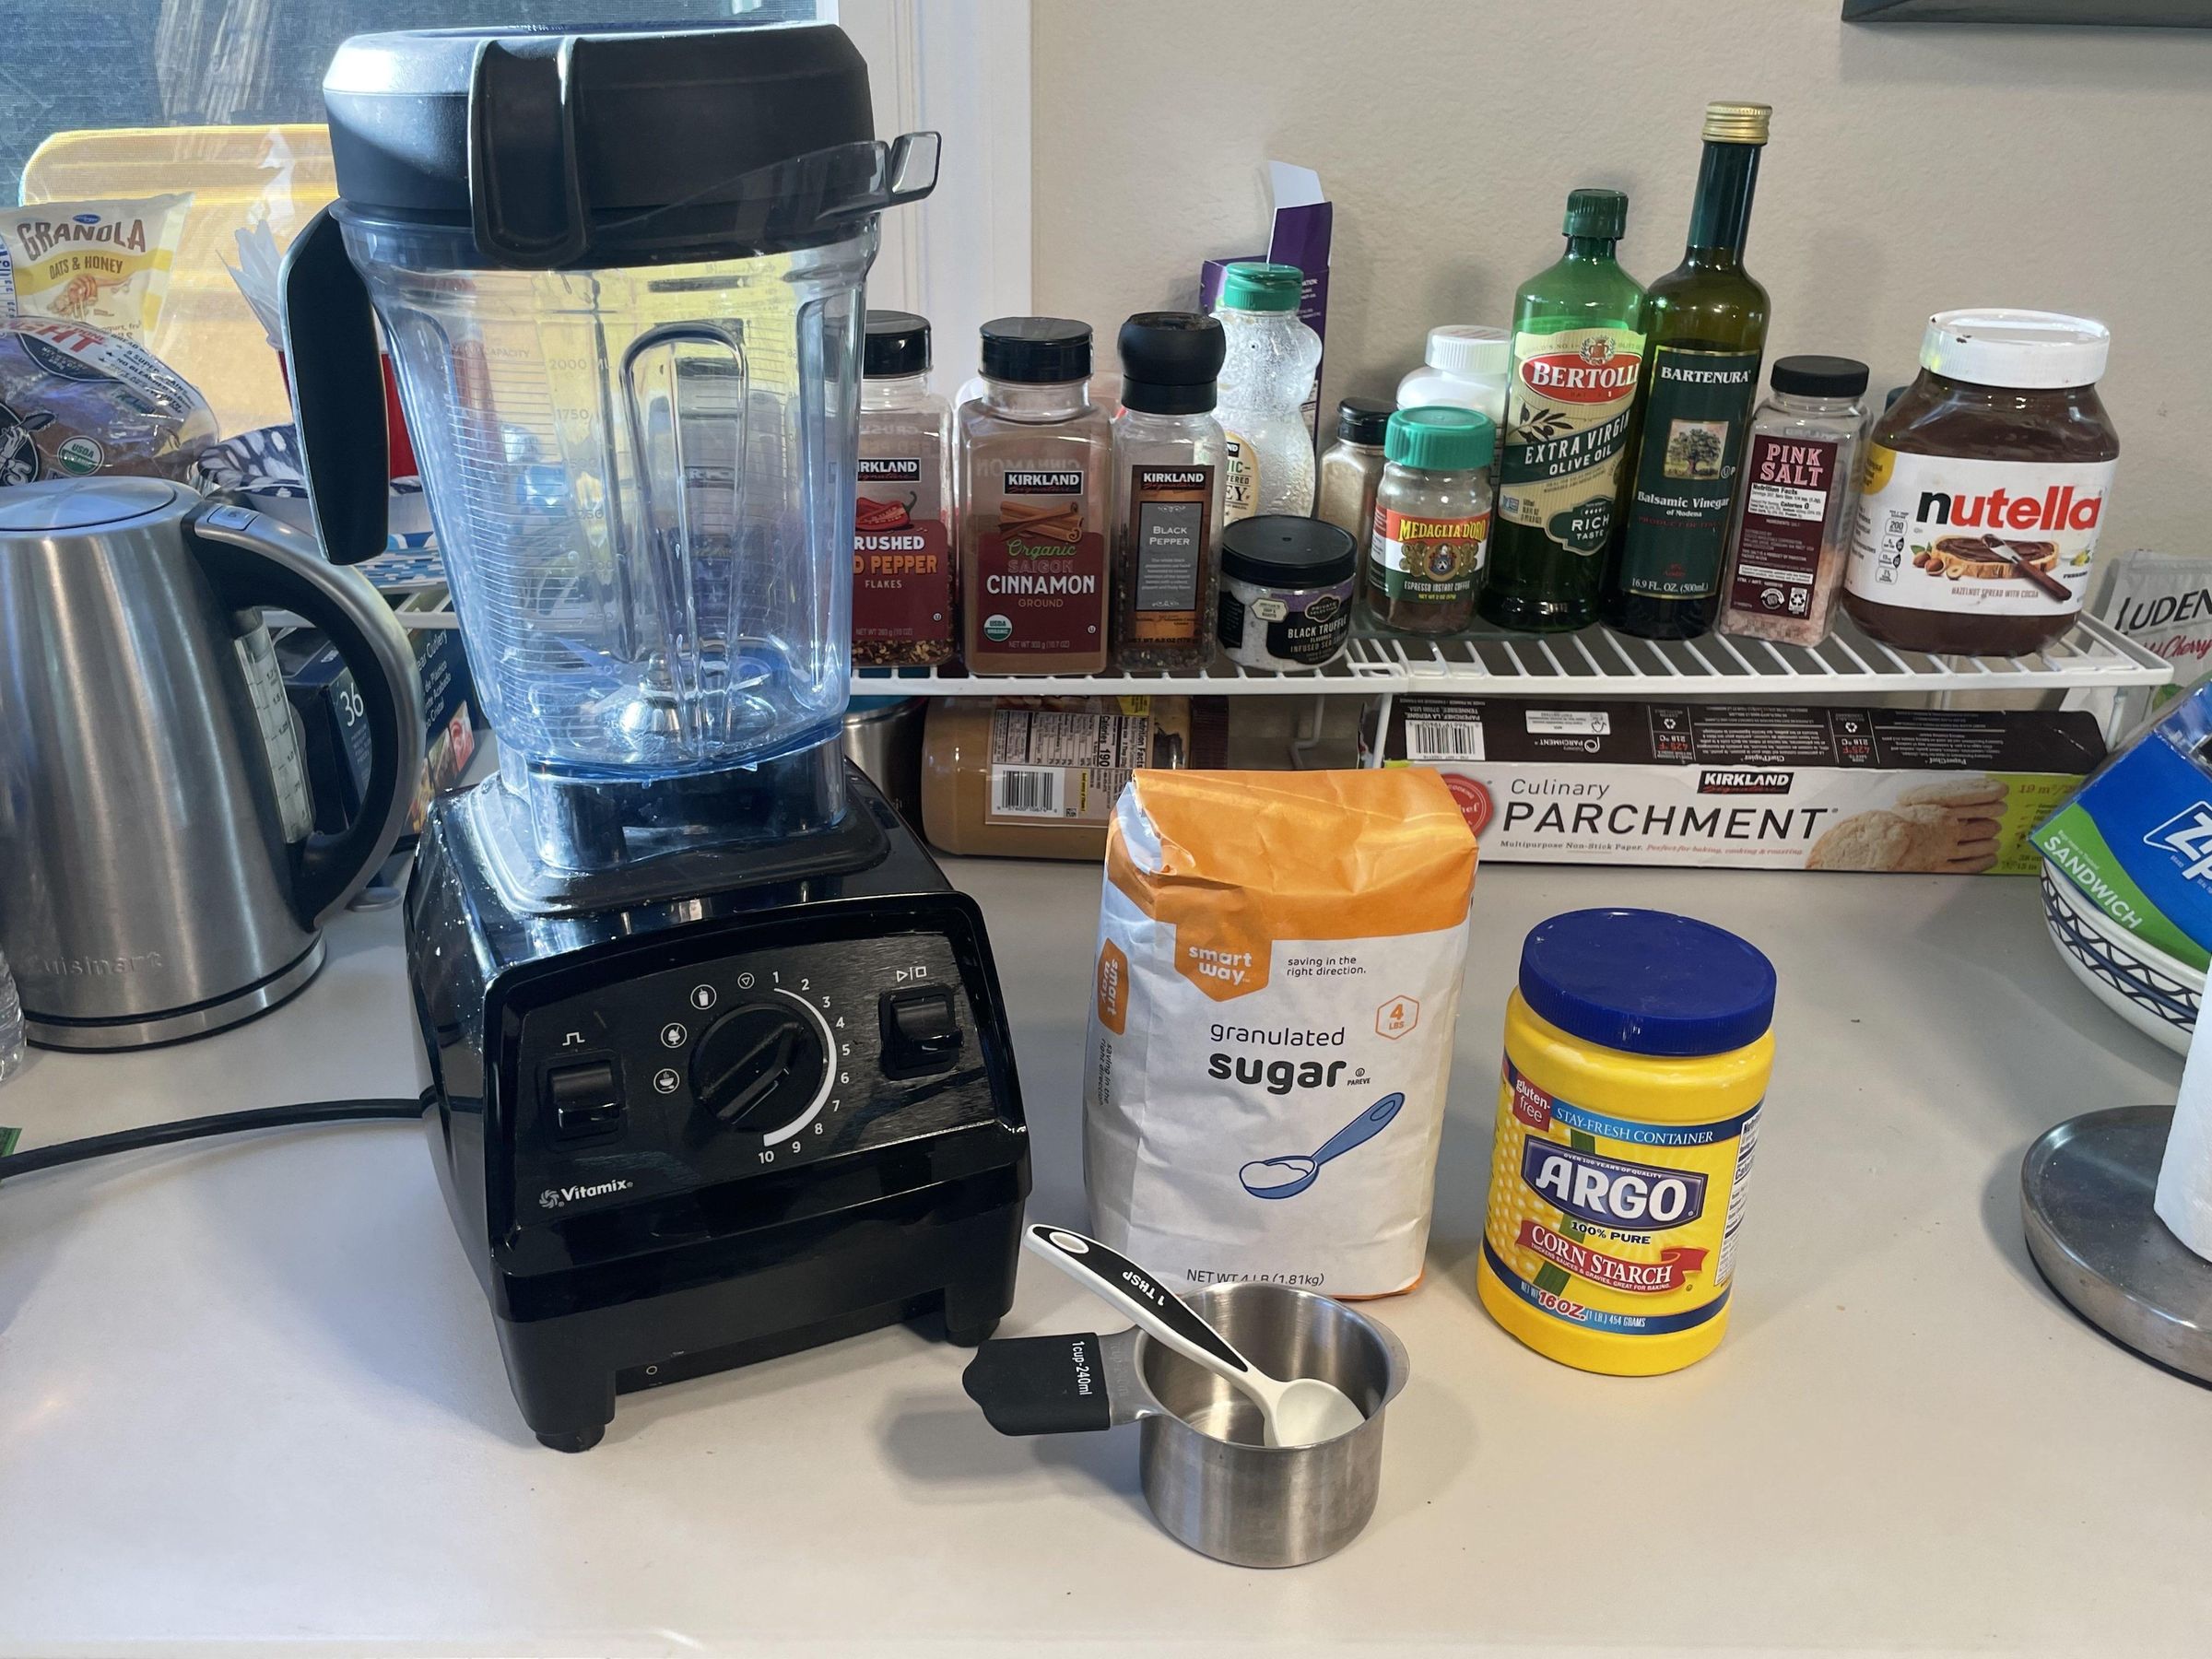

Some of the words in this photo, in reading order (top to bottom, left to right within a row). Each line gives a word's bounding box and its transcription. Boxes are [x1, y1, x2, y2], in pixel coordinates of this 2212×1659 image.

[18, 219, 146, 261] GRANOLA
[50, 257, 70, 279] OATS
[72, 257, 80, 270] &
[85, 256, 123, 274] HONEY
[548, 359, 587, 370] 2000
[1661, 366, 1748, 384] BARTENURA
[557, 409, 589, 420] 1750
[1524, 436, 1581, 465] EXTRA
[1588, 409, 1630, 451] VIRGIN
[71, 443, 95, 459] USDA
[1549, 452, 1591, 476] OLIVE
[1594, 443, 1613, 463] OIL
[1766, 442, 1823, 466] PINK
[1008, 474, 1080, 486] KIRKLAND
[1143, 472, 1205, 483] KIRKLAND
[1759, 462, 1824, 488] SALT
[1753, 483, 1780, 493] Nutrition
[1781, 487, 1798, 495] Facts
[1637, 491, 1688, 508] Balsamic
[1693, 496, 1730, 511] Vinegar
[1781, 500, 1803, 509] Calories
[1916, 486, 2102, 531] nutella
[1571, 513, 1610, 532] RICH
[1676, 510, 1702, 518] Modena
[1398, 519, 1461, 542] MEDAGLIA
[1889, 521, 1904, 531] 200
[853, 535, 925, 550] RUSHED
[1577, 530, 1605, 541] TASTE
[1006, 539, 1077, 560] Organic
[870, 555, 938, 575] PEPPER
[1008, 559, 1074, 574] SAIGON
[865, 580, 902, 589] FLAKES
[986, 575, 1095, 594] CINNAMON
[1404, 581, 1431, 593] ESPRESSO
[1631, 578, 1648, 589] 16.9
[1648, 581, 1662, 591] FL.
[1664, 582, 1678, 593] OZ.
[1951, 586, 1981, 597] HAZELNUT
[1981, 587, 2005, 598] SPREAD
[2005, 588, 2019, 598] WITH
[2020, 590, 2039, 598] COCOA
[1018, 598, 1064, 608] GROUND
[1288, 628, 1316, 639] BLACK
[426, 629, 449, 660] Cutlery
[339, 682, 364, 727] 36
[1099, 715, 1111, 745] Calories
[1540, 738, 1583, 747] PARCHMENT
[1099, 748, 1111, 767] 190
[1135, 748, 1147, 769] Facts
[1704, 772, 1790, 786] KIRKLAND
[1511, 778, 1610, 800] Culinary
[1502, 802, 1829, 841] PARCHMENT
[1500, 840, 1563, 850] Multipurpose
[1566, 841, 1612, 851] Non-Stick
[1616, 843, 1643, 852] Paper.
[2043, 836, 2143, 930] SANDWICH
[1188, 946, 1252, 968] smart
[1288, 957, 1322, 968] saving
[1325, 956, 1335, 966] in
[1339, 956, 1357, 965] the
[772, 971, 781, 983] 1
[1199, 962, 1246, 985] way
[1287, 966, 1312, 978] right
[1316, 965, 1367, 977] direction.
[800, 978, 810, 991] 2
[1100, 960, 1109, 1004] way
[1108, 959, 1119, 1016] smart
[822, 995, 830, 1009] 3
[1390, 1004, 1405, 1022] 4
[835, 1017, 845, 1030] 4
[1389, 1020, 1405, 1030] LBS
[1210, 1023, 1346, 1047] granulated
[841, 1044, 850, 1056] 5
[840, 1072, 850, 1085] 6
[1105, 1075, 1112, 1086] in
[1207, 1053, 1347, 1095] sugar
[1347, 1077, 1371, 1086] PAREVE
[1516, 1078, 1550, 1110] gluten-
[832, 1100, 841, 1112] 7
[1519, 1095, 1544, 1123] free
[814, 1122, 823, 1135] 8
[1556, 1108, 1630, 1139] STAY-FRESH
[1633, 1130, 1713, 1145] CONTAINER
[792, 1141, 801, 1153] 9
[758, 1150, 774, 1164] 10
[1563, 1153, 1582, 1163] OVER
[1596, 1161, 1619, 1172] YEARS
[1630, 1168, 1663, 1179] QUALITY
[561, 1179, 627, 1203] Vitamix
[1535, 1155, 1688, 1222] ARGO
[1571, 1221, 1606, 1240] 100%
[1610, 1232, 1652, 1244] PURE
[1532, 1225, 1588, 1267] CORN
[1590, 1254, 1674, 1284] STARCH
[1531, 1242, 1556, 1262] THICKENS
[1556, 1256, 1579, 1273] SAUCES
[1613, 1280, 1633, 1290] GREAT
[1647, 1282, 1672, 1290] BAKING.
[1123, 1271, 1156, 1300] TBSP
[1187, 1269, 1216, 1284] NET
[1218, 1273, 1238, 1282] WT
[1273, 1273, 1325, 1286] (1.81kg)
[1158, 1295, 1165, 1306] 1
[1521, 1280, 1530, 1293] NET
[1609, 1315, 1622, 1326] 454
[1623, 1316, 1646, 1327] GRAMS
[1072, 1340, 1092, 1396] 1cup-240ml
